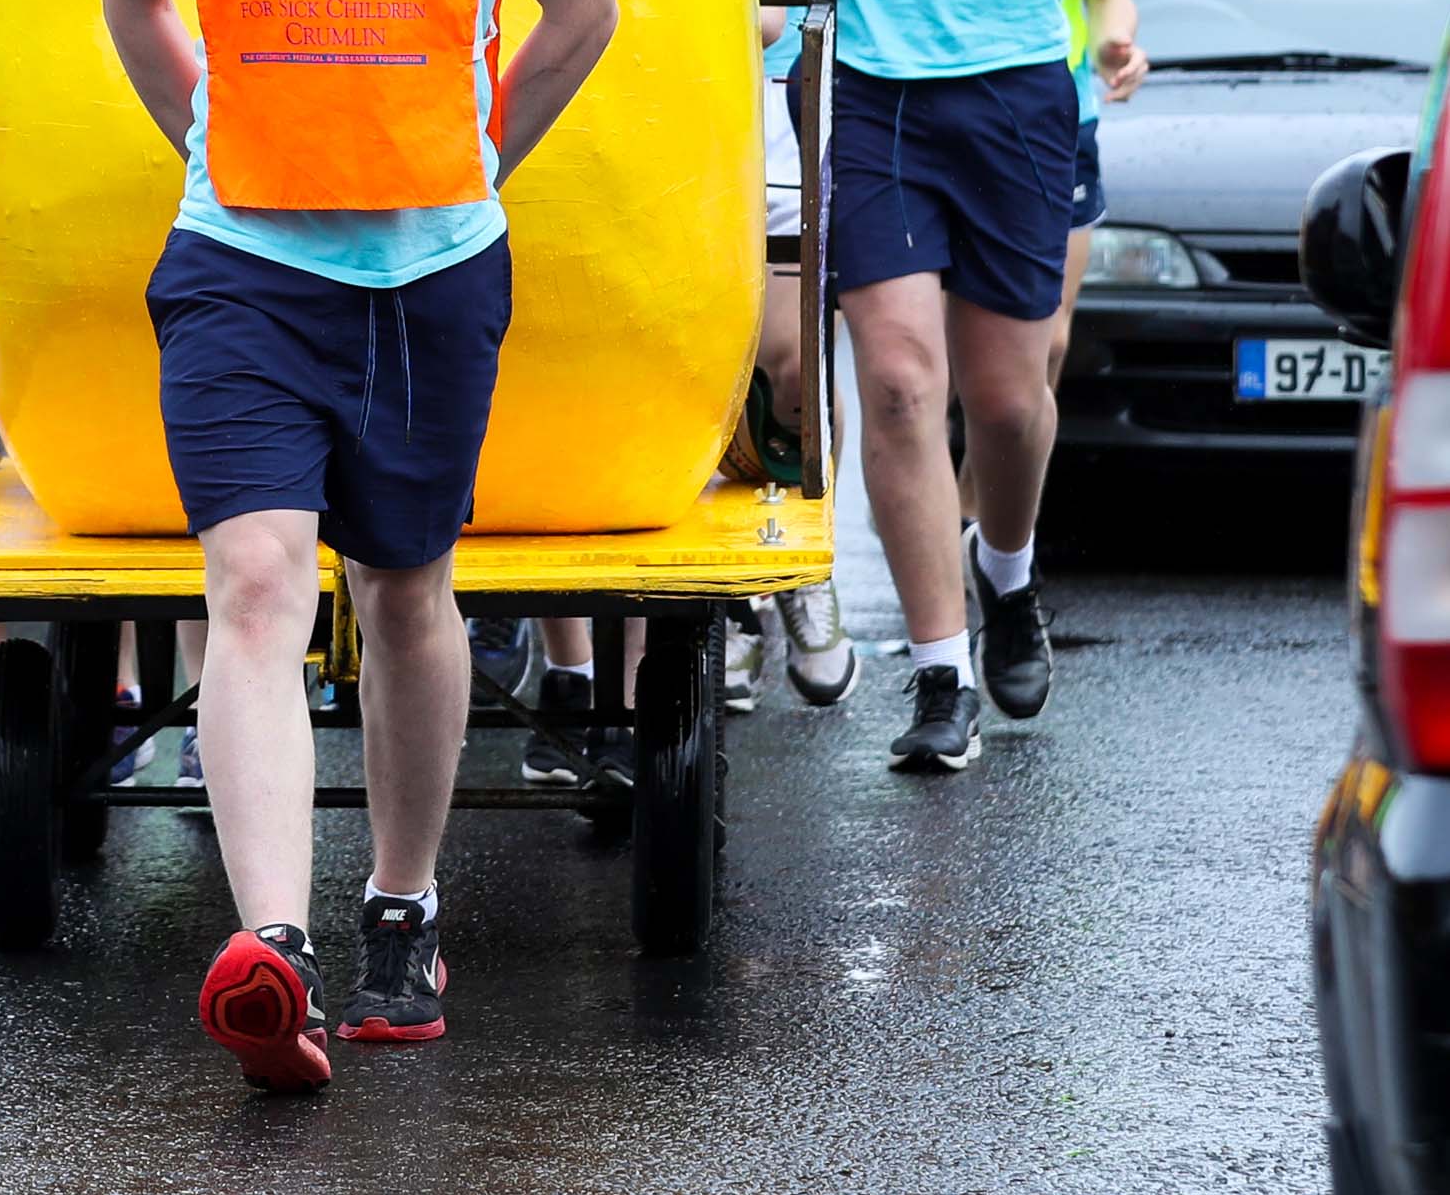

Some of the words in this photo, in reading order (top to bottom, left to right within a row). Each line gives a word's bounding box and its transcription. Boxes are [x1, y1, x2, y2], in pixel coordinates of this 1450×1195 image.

[334, 55, 376, 63] RESEARCH
[378, 55, 423, 64] FOUNDATION
[382, 909, 407, 921] NIKE
